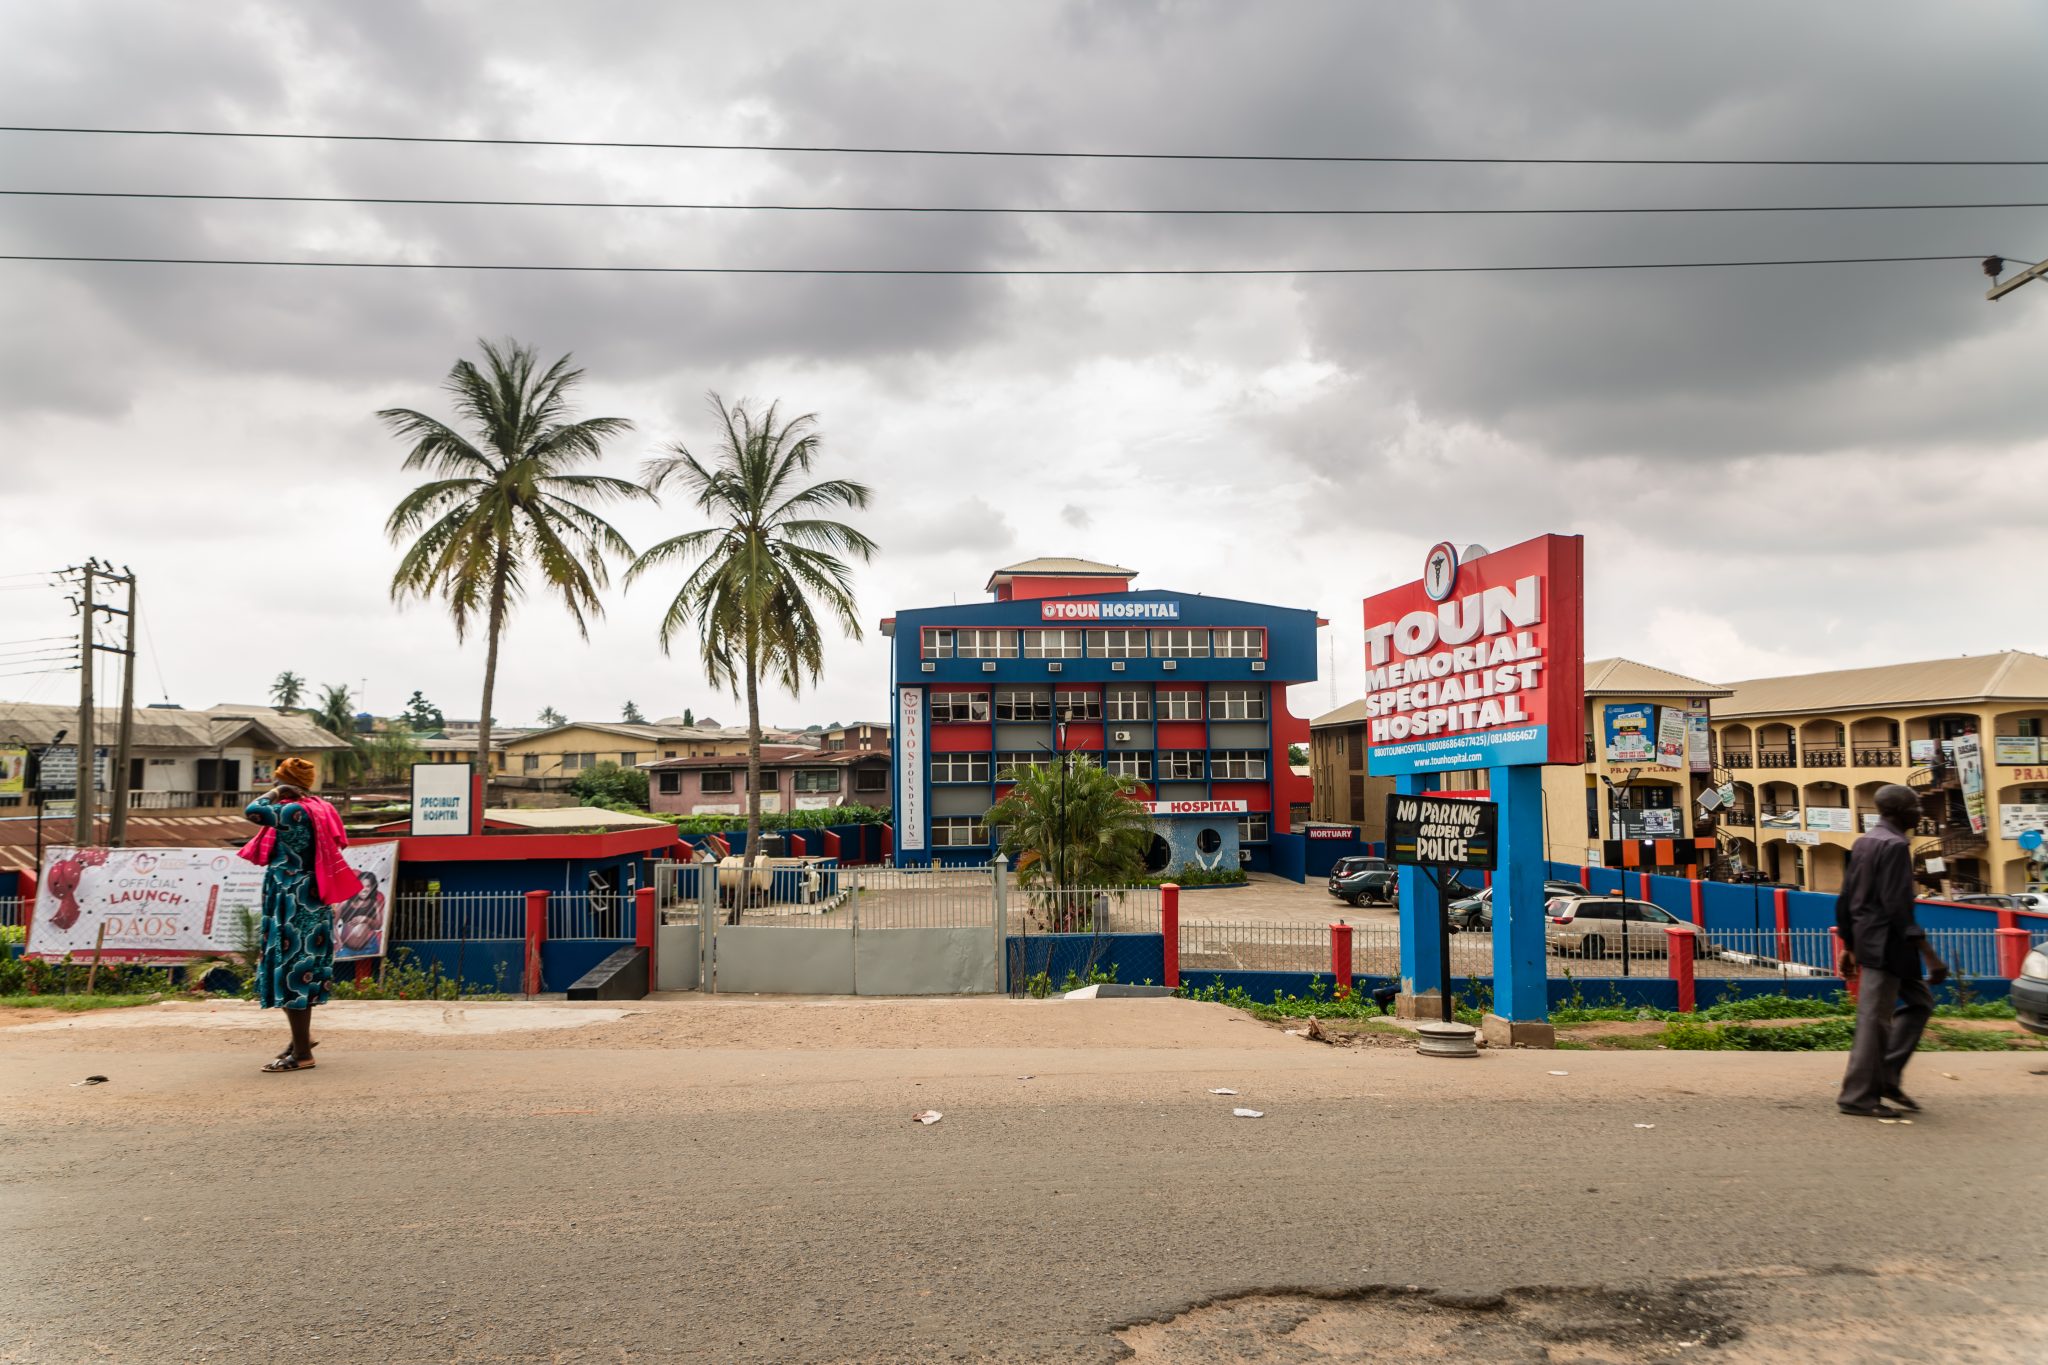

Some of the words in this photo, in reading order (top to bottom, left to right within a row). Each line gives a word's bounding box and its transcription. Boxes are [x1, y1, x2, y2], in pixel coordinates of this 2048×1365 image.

[1056, 603, 1100, 618] TOUN
[1102, 603, 1178, 618] HOSPITAL
[1364, 575, 1541, 666] TOUN
[1364, 631, 1542, 693] MEMORIAL
[1366, 661, 1543, 718] SPECIALIST
[1372, 695, 1529, 743] HOSPITAL
[1413, 752, 1482, 767] www.tounhospital.com
[420, 796, 460, 808] SPECIALIST
[1171, 801, 1240, 813] HOSPITAL
[423, 810, 458, 821] HOSPITAL
[1396, 800, 1418, 822] NO
[1420, 801, 1481, 826] PARKING
[1310, 830, 1353, 838] MORTUARY
[1420, 823, 1460, 839] ORDER
[1416, 837, 1468, 862] POLICE
[119, 878, 178, 889] OFFICIAL
[109, 889, 183, 906] LAUNCH
[103, 916, 177, 937] DAOS
